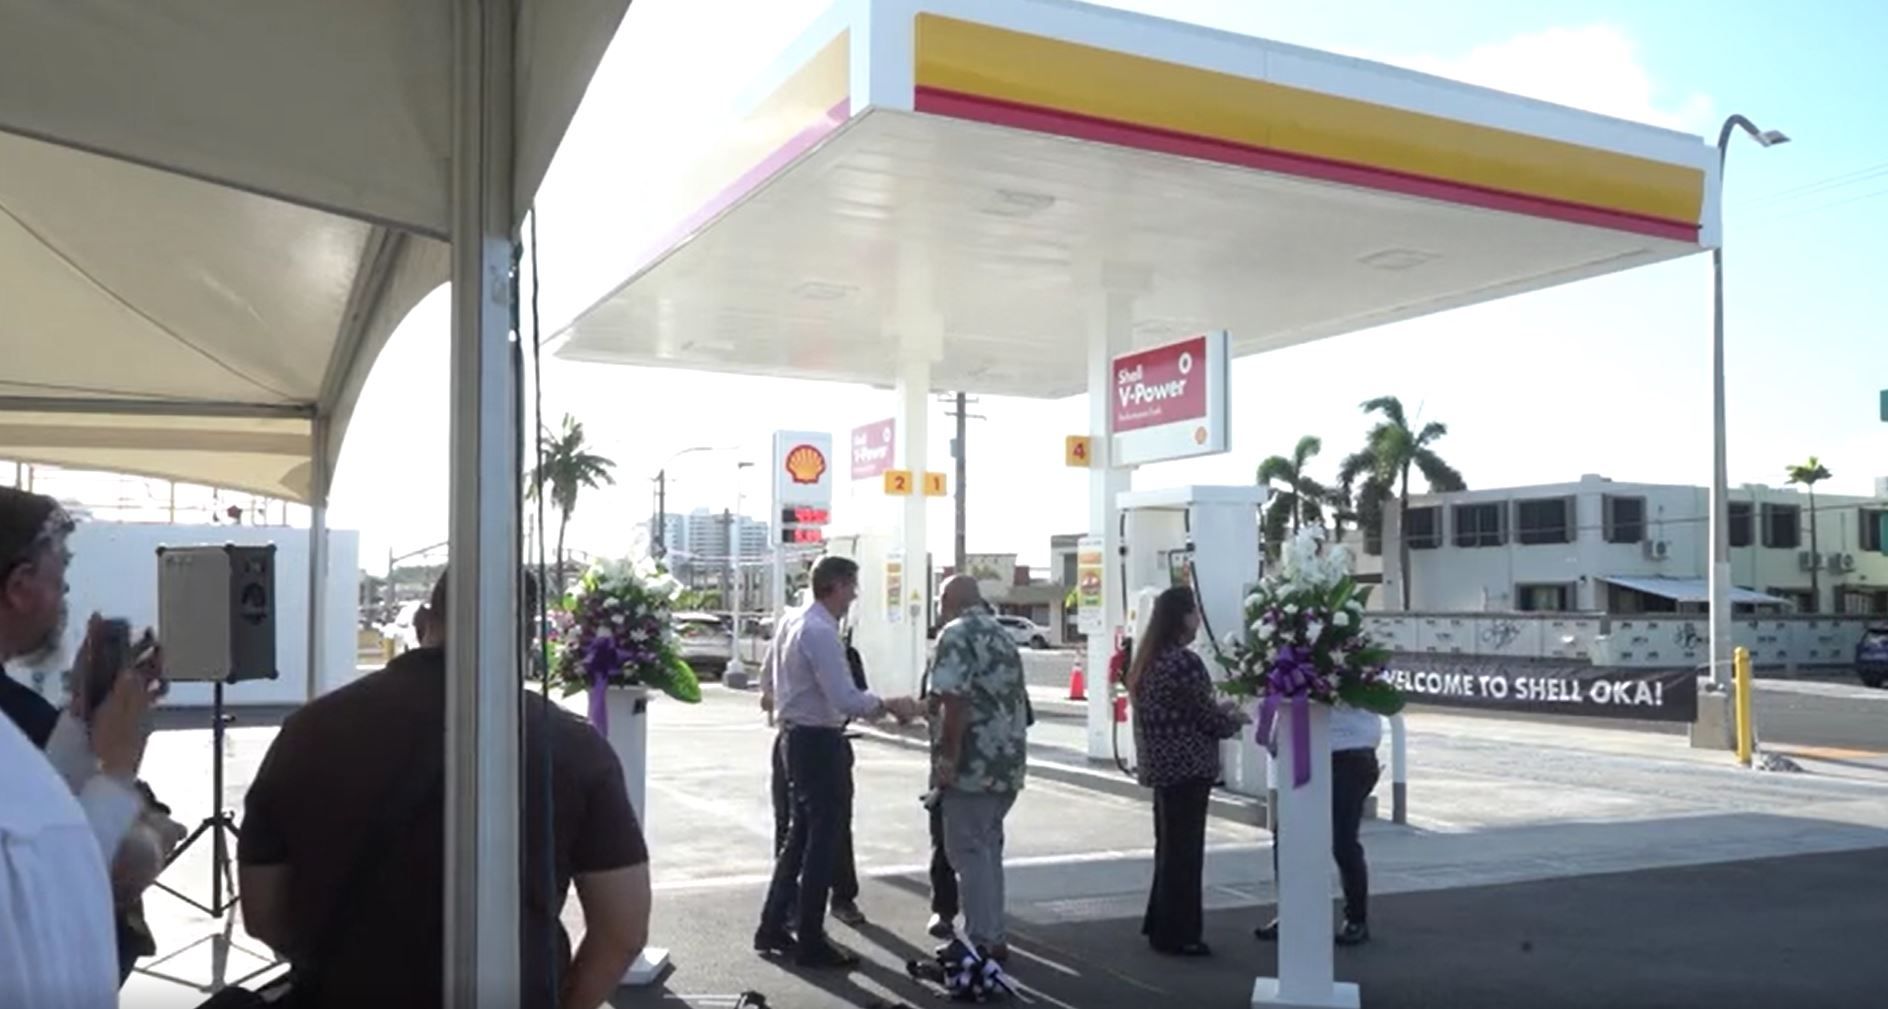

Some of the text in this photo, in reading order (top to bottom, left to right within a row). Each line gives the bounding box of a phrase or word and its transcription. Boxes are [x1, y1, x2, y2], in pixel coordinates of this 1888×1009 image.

[1118, 364, 1143, 385] Shell
[1118, 379, 1187, 407] V-Power
[1073, 442, 1086, 460] 4
[894, 476, 905, 490] 2
[934, 475, 940, 491] 1
[1479, 675, 1508, 699] TO
[1514, 676, 1583, 702] SHELL
[1590, 680, 1664, 706] OKA!
